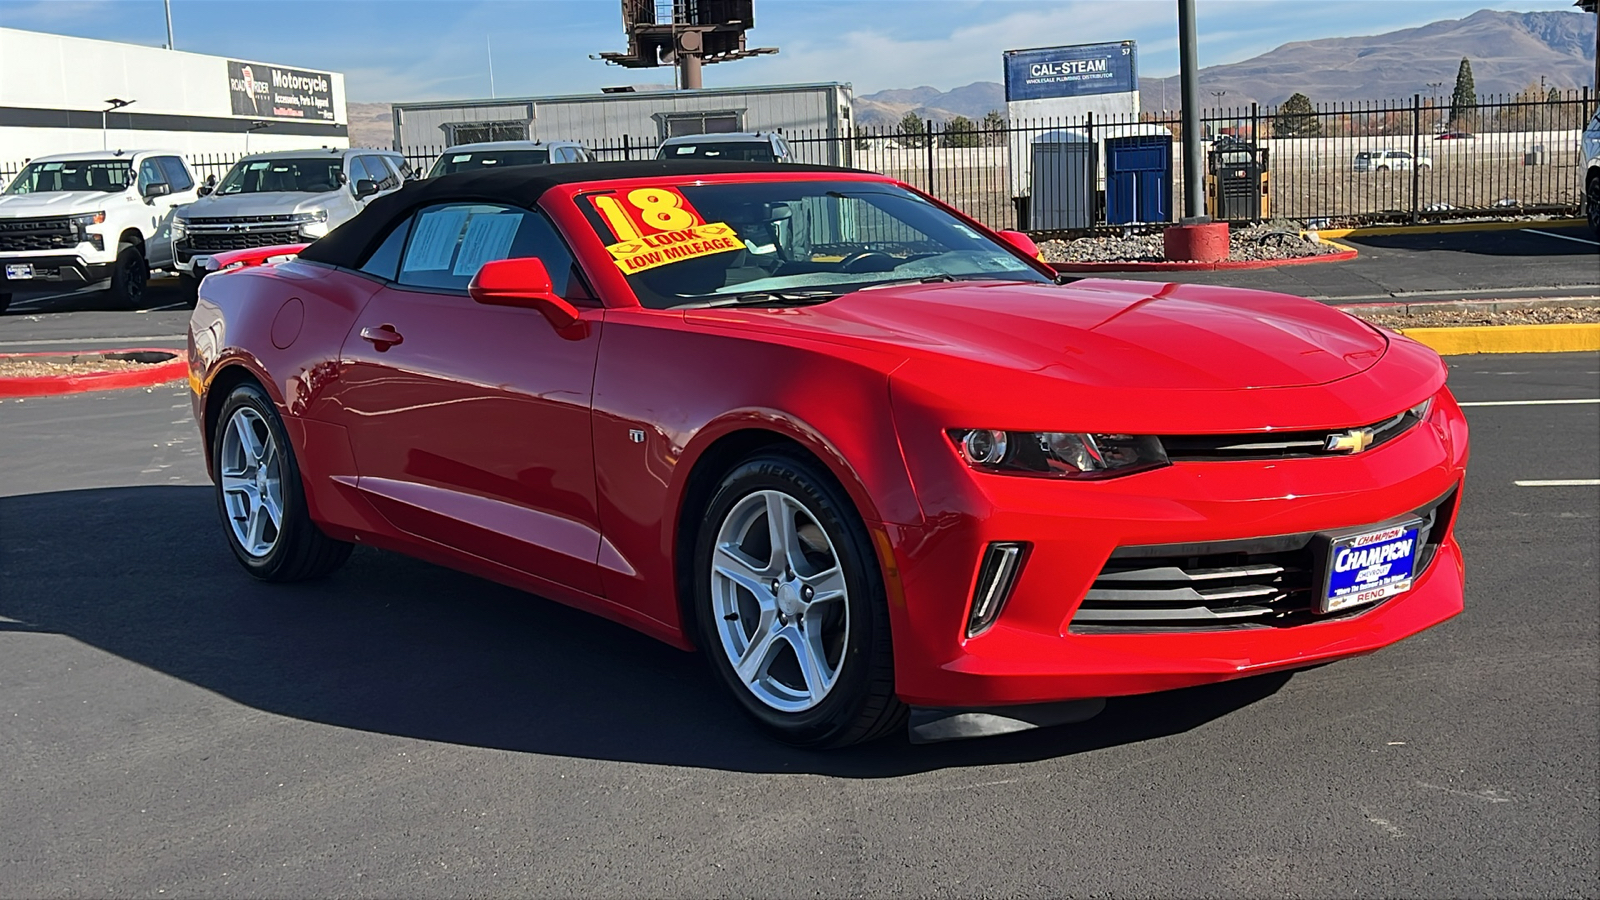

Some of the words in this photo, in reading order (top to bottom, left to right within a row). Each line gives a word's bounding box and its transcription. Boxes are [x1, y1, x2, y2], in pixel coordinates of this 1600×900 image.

[1122, 48, 1130, 56] 57
[1031, 59, 1106, 77] CAL-STEAM
[231, 78, 246, 92] ROAD
[253, 81, 269, 94] RIDER
[272, 69, 328, 95] Motorcycle
[1026, 77, 1055, 85] WHOLESALE
[594, 187, 698, 242] 18
[642, 228, 701, 248] LOOK
[625, 251, 661, 270] LOW
[663, 237, 734, 259] MILEAGE
[1357, 529, 1400, 546] CHAMPION
[1334, 539, 1413, 573] CHAMPION
[1359, 566, 1388, 579] CHEVROLET
[1357, 588, 1385, 602] RENO
